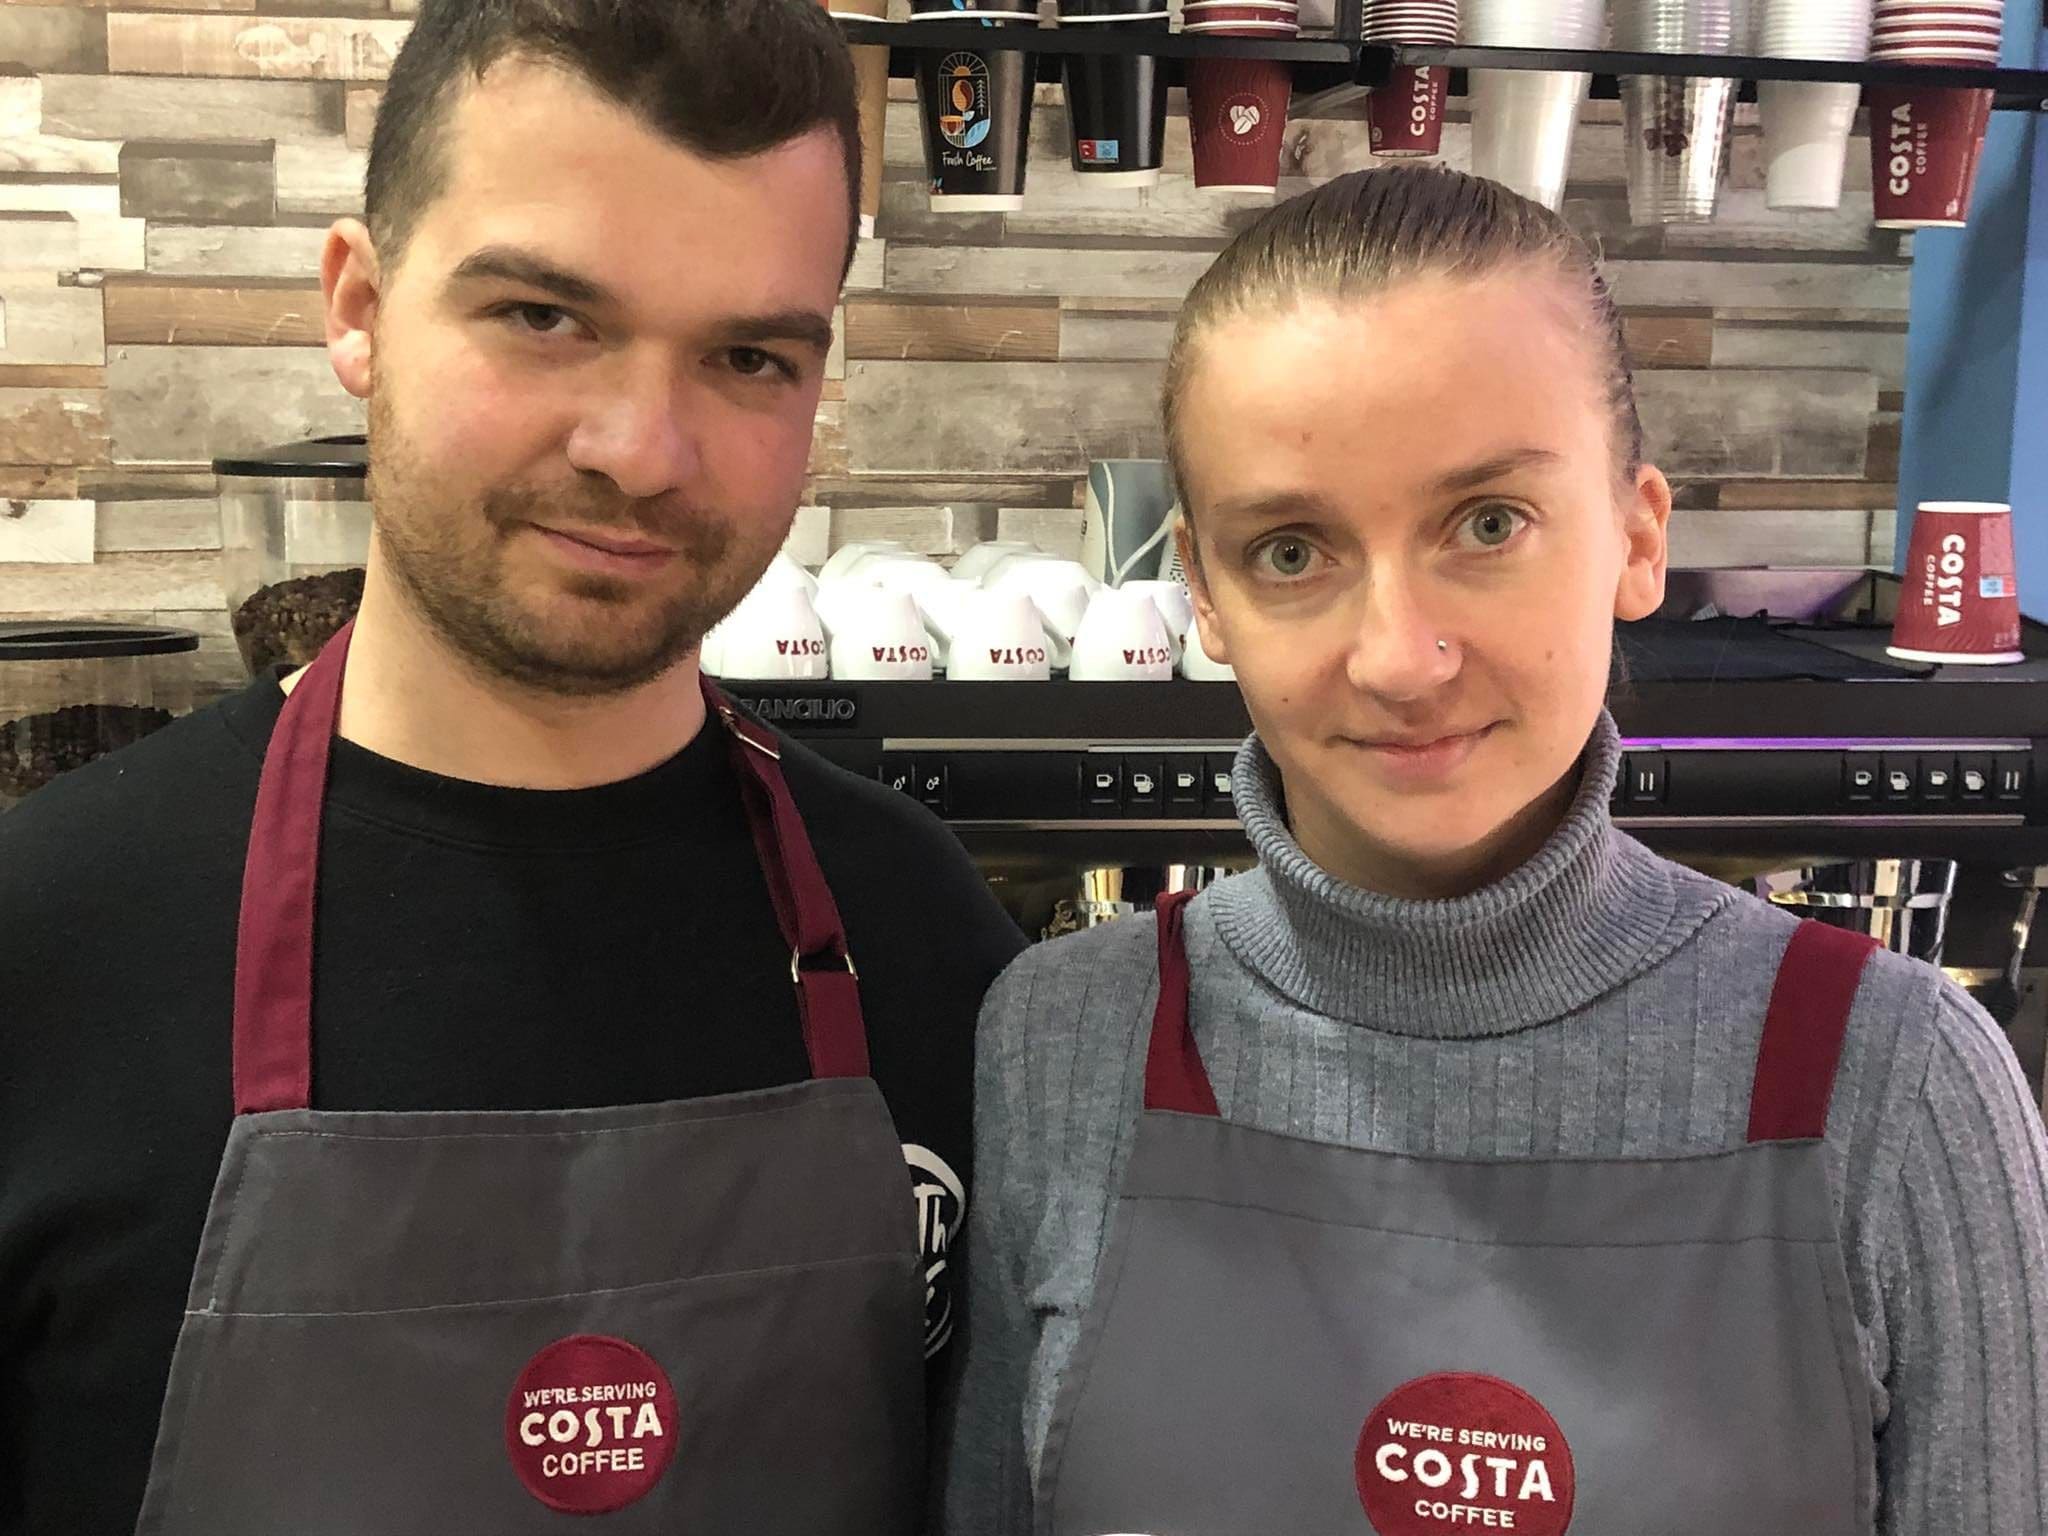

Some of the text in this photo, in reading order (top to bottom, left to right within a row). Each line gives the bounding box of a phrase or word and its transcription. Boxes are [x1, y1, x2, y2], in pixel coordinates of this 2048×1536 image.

[1410, 65, 1430, 137] COSTA
[965, 150, 993, 171] Coffee
[1889, 102, 1912, 196] COSTA
[1915, 122, 1928, 175] COFFEE
[1923, 554, 1936, 606] COFFEE
[1936, 533, 1966, 627] COSTA
[872, 645, 928, 662] COSTA
[990, 647, 1045, 664] COSTA
[524, 1381, 657, 1408] WE'RE SERVING
[519, 1402, 664, 1448] COSTA
[1386, 1418, 1547, 1452] WE'RE SERVING
[542, 1447, 645, 1478] COFFEE
[1375, 1442, 1556, 1502] COSTA
[1414, 1499, 1516, 1529] COFFEE
